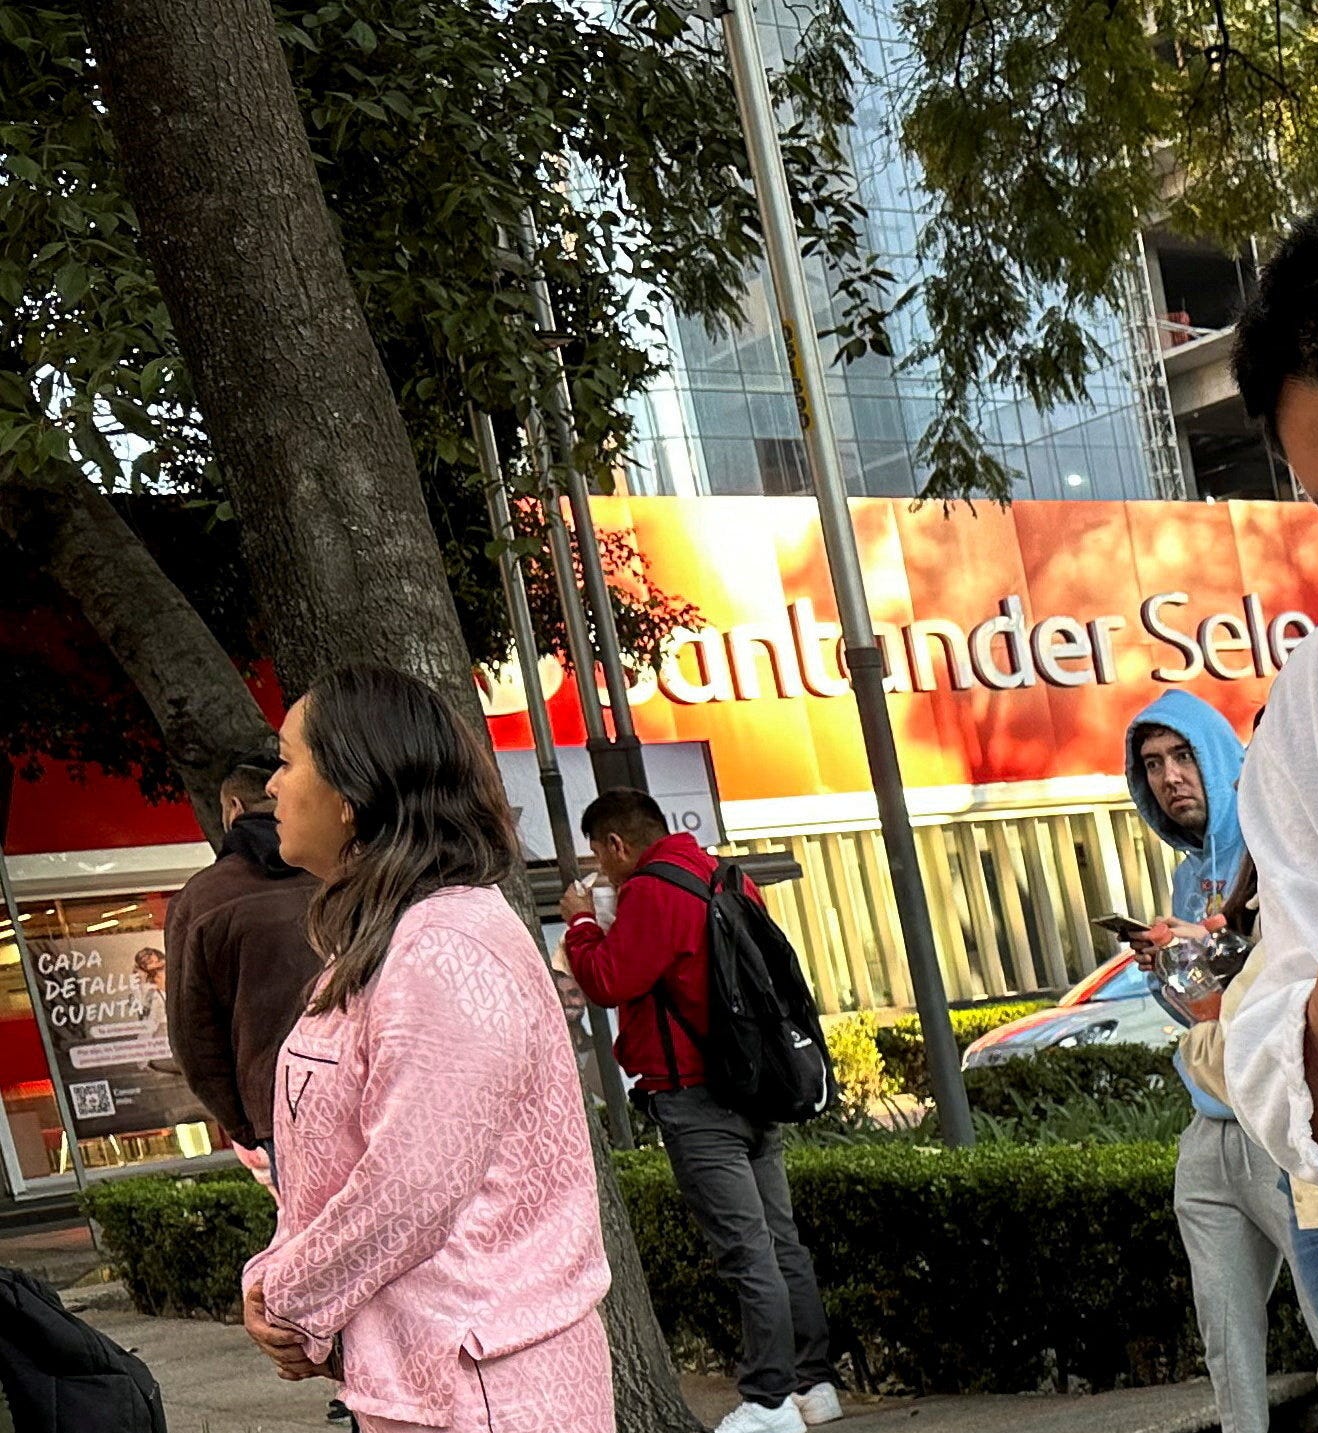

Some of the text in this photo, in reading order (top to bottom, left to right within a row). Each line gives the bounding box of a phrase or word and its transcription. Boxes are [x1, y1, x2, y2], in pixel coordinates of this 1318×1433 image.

[38, 950, 102, 975] CADA
[44, 972, 142, 1001] DETALLE
[51, 997, 144, 1027] CUENTA
